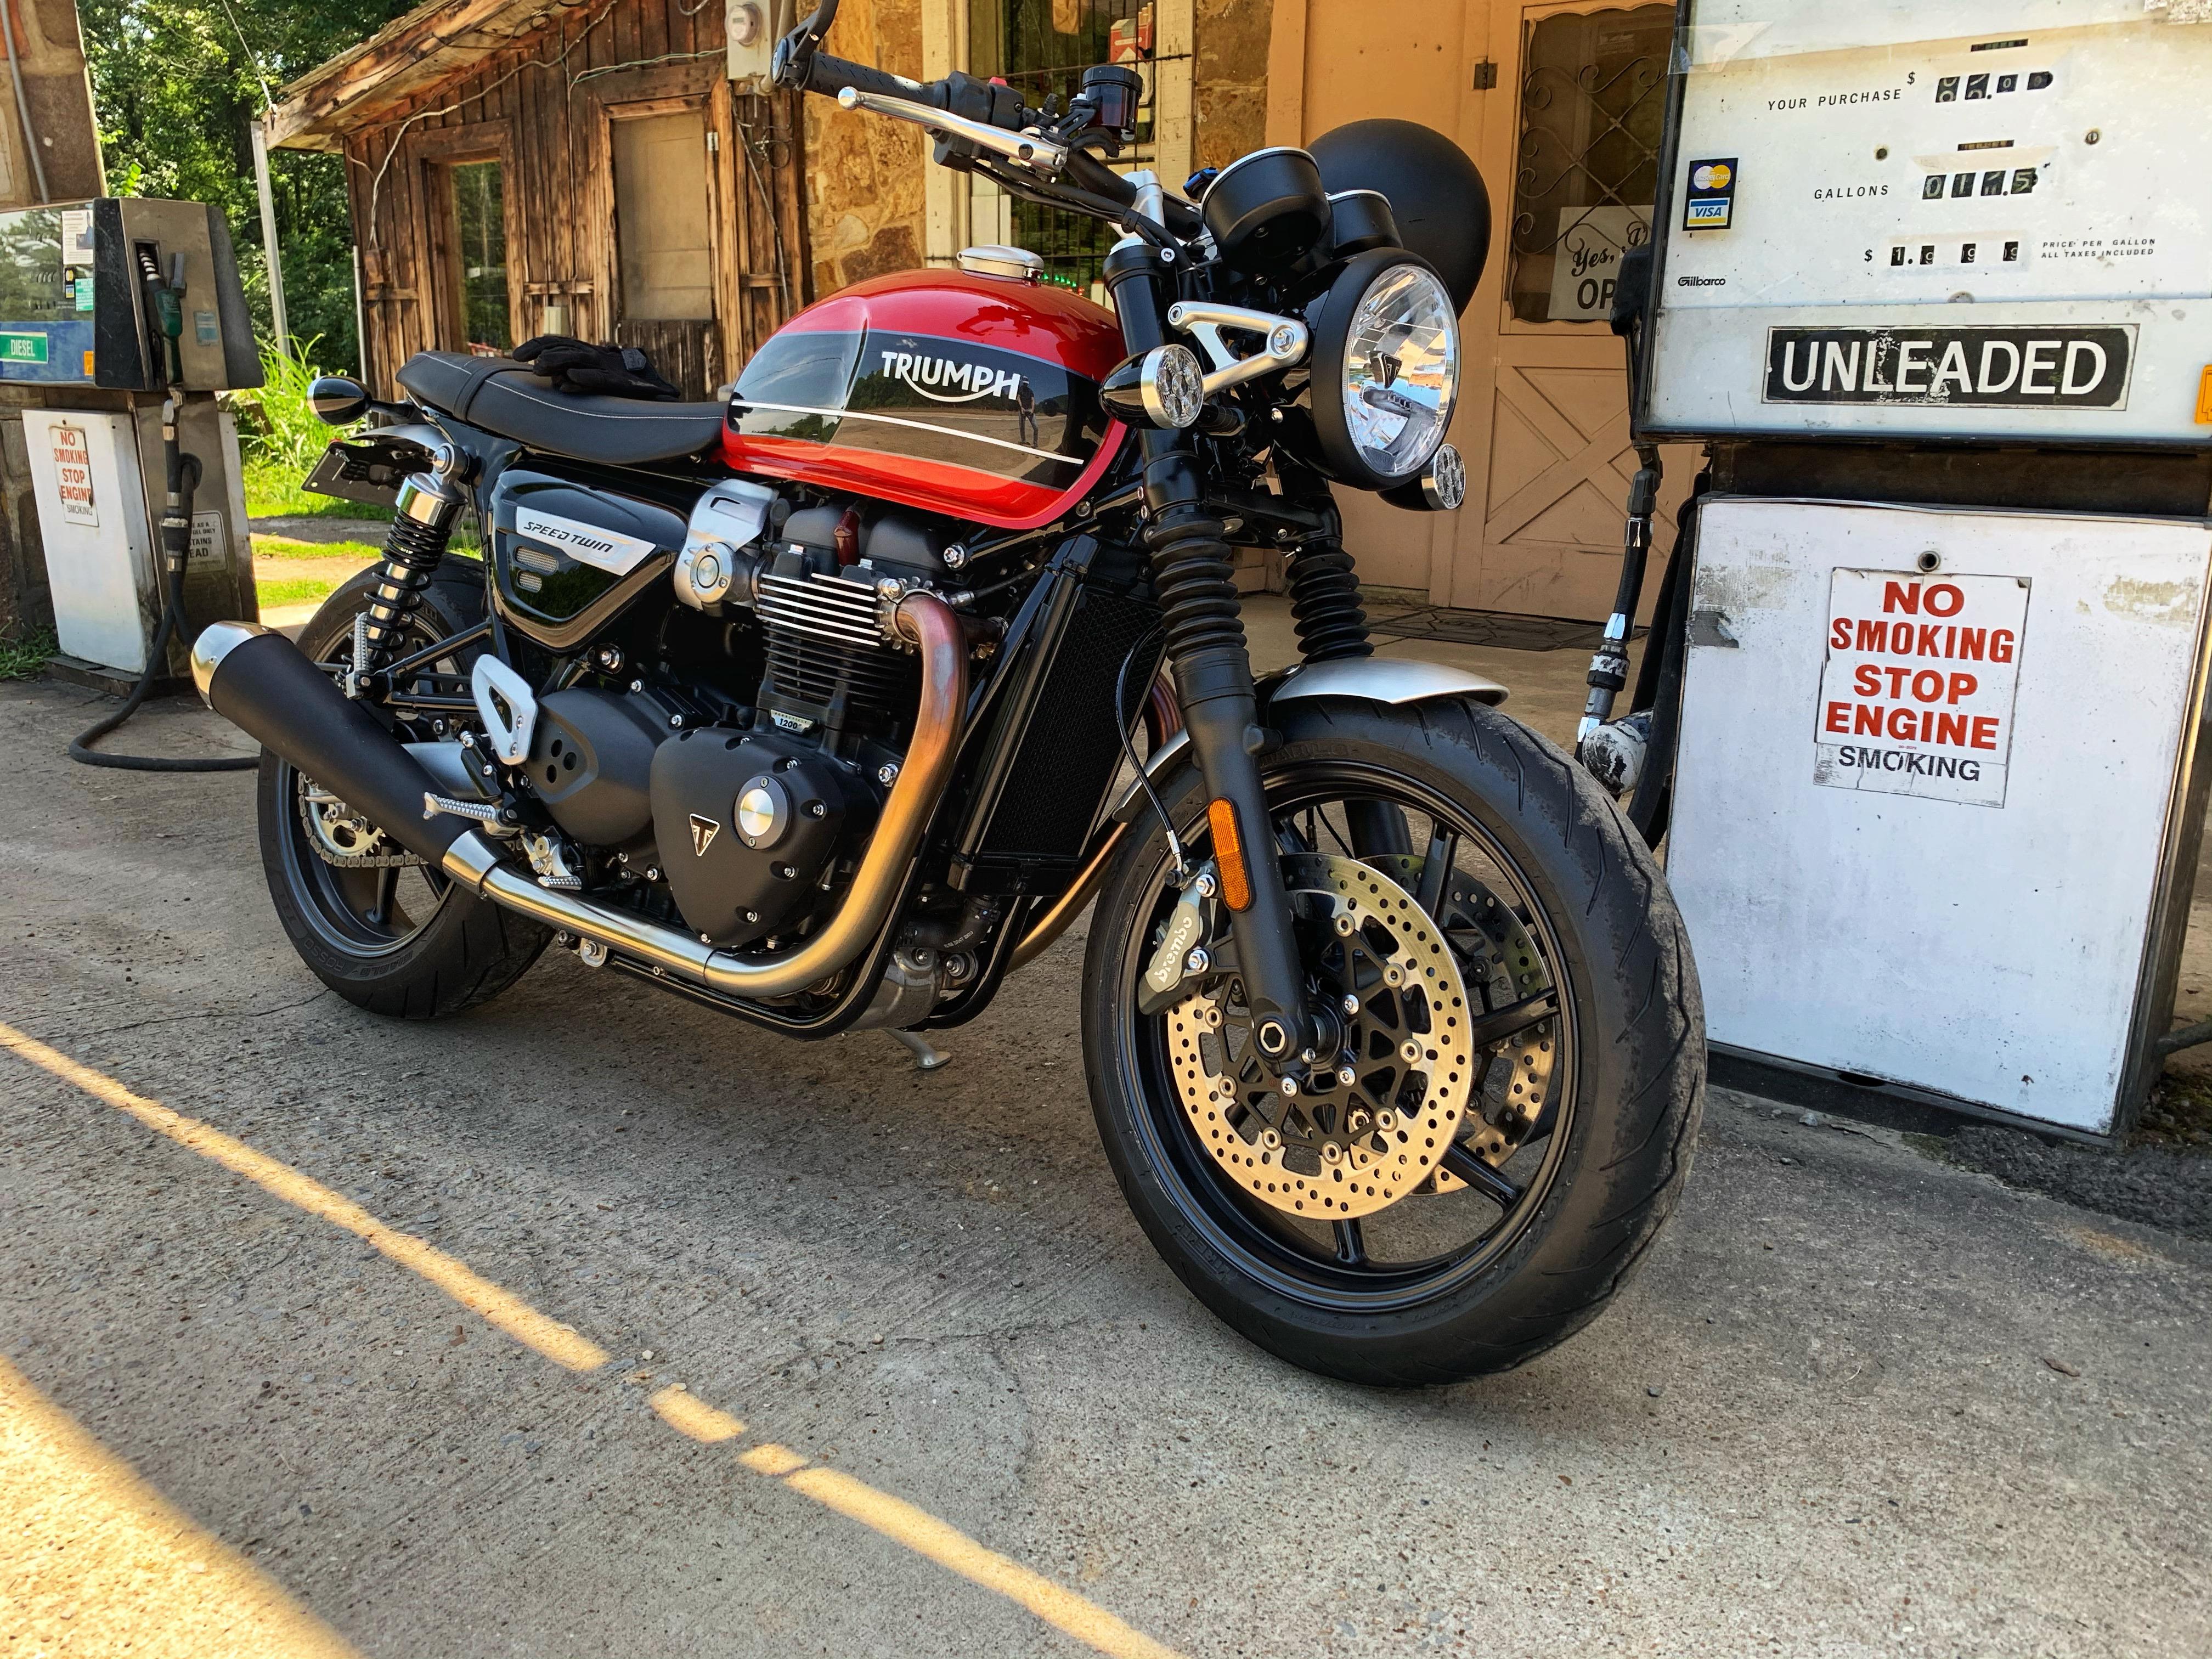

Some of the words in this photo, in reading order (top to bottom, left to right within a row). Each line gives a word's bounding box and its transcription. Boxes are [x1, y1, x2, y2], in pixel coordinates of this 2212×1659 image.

[1768, 98, 1807, 110] YOUR
[1818, 89, 1901, 106] PURCHASE
[1907, 71, 1915, 85] $
[1814, 185, 1888, 199] GALLONS
[1695, 207, 1723, 217] VISA
[1864, 249, 1872, 262] $
[1577, 278, 1618, 309] OP
[1678, 276, 1726, 286] Gilbarco
[10, 339, 35, 357] DIESEL
[882, 351, 1020, 402] TRIUMPH
[1783, 340, 2107, 394] UNLEADED
[60, 431, 76, 447] NO
[54, 448, 88, 465] SMOKING
[62, 468, 85, 484] STOP
[66, 504, 93, 516] SMOKING
[523, 522, 571, 539] SPEED
[571, 534, 614, 552] TWIN
[189, 548, 208, 558] EAD
[1883, 581, 1965, 617] NO
[1831, 617, 2015, 663] SMOKING
[1853, 664, 1978, 704] STOP
[780, 718, 798, 729] 1200
[1825, 701, 2000, 750] ENGINE
[1839, 746, 1980, 781] SMOKING
[303, 938, 345, 972] ROSSO
[1154, 917, 1192, 983] brembo
